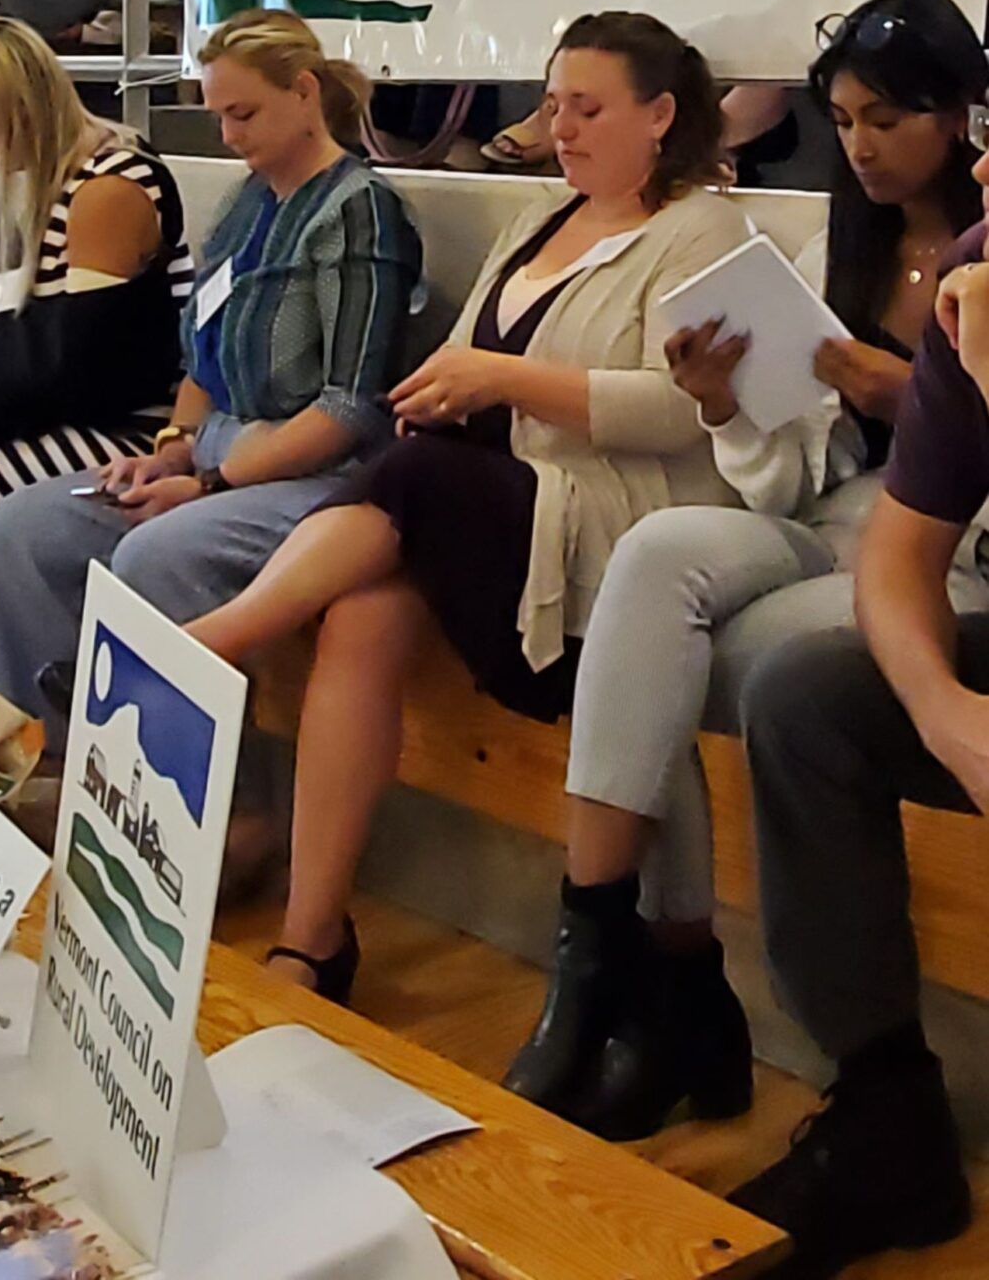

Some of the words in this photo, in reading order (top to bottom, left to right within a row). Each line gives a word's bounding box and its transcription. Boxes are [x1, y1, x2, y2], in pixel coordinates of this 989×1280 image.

[46, 956, 77, 1032] Rural
[73, 1005, 161, 1181] Development
[53, 890, 101, 997] Vermont
[99, 969, 153, 1077] Council
[150, 1058, 174, 1112] on
